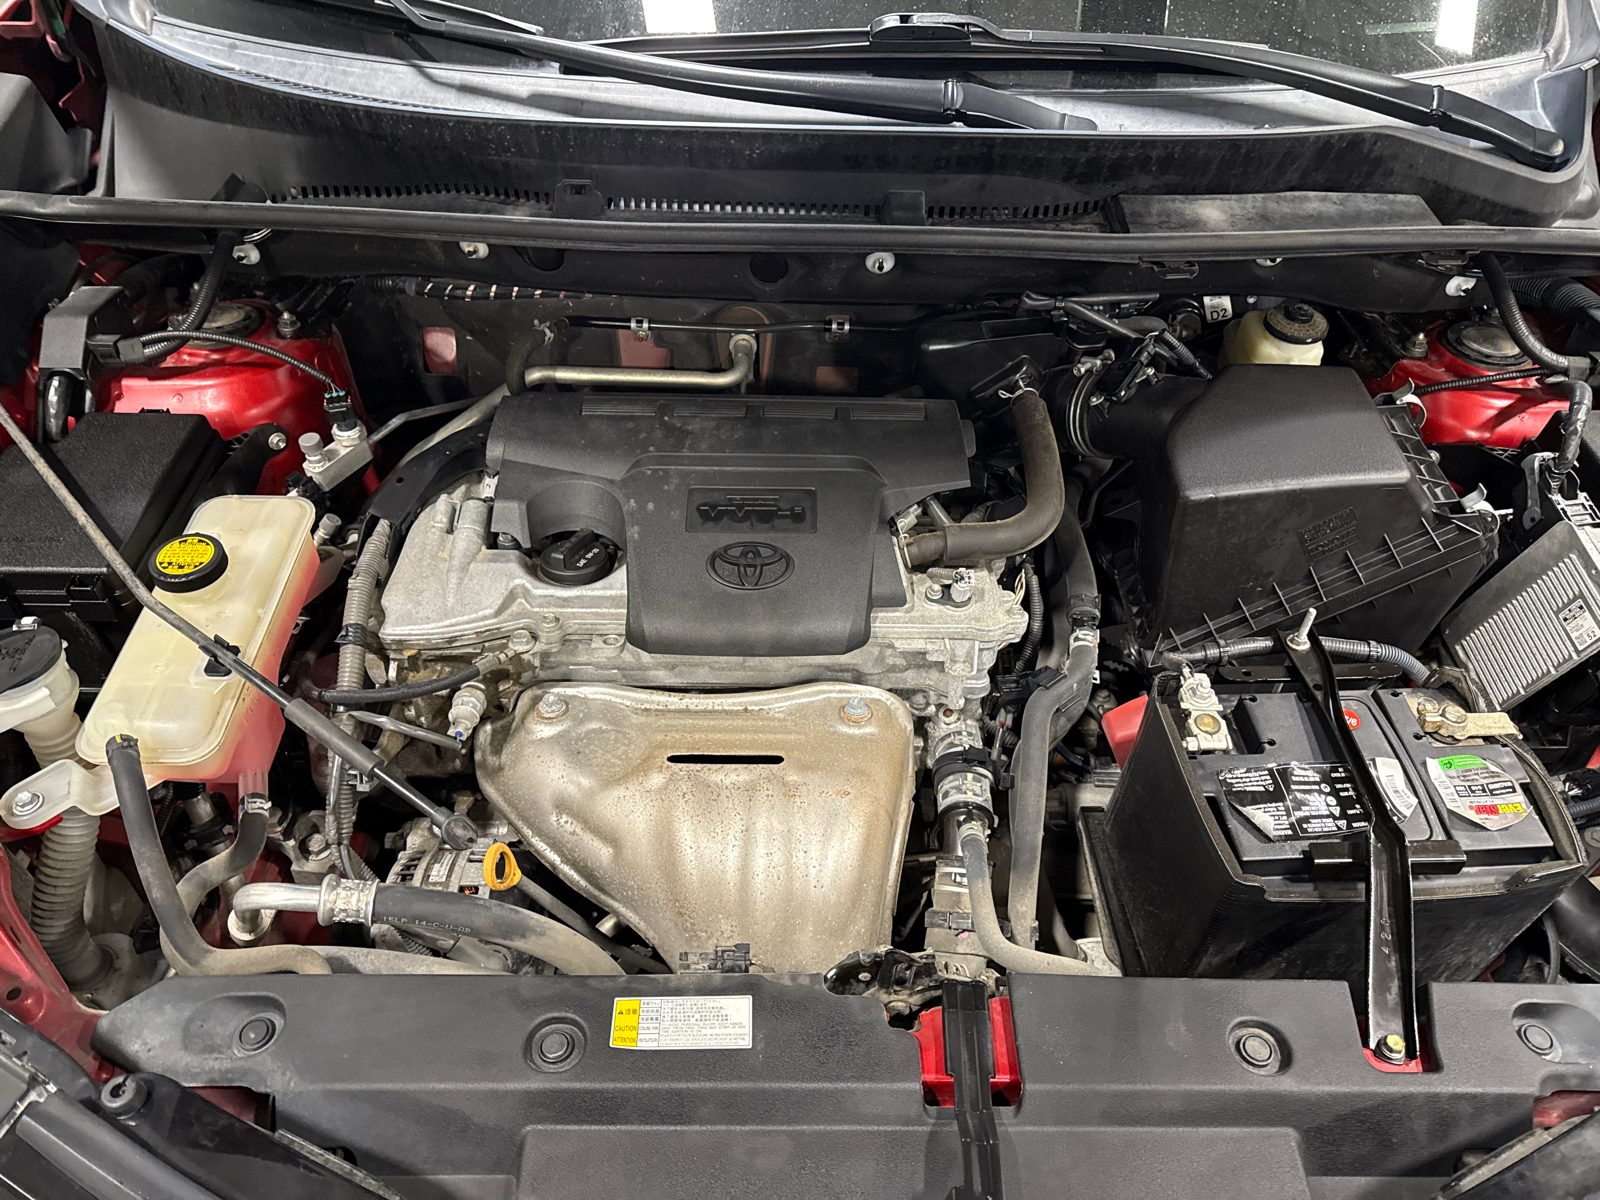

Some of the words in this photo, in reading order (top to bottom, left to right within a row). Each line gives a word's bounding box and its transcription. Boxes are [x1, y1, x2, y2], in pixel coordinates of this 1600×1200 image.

[1210, 307, 1228, 321] D2
[576, 558, 588, 568] SAE
[1586, 630, 1598, 641] 52
[1475, 803, 1524, 816] EverStar
